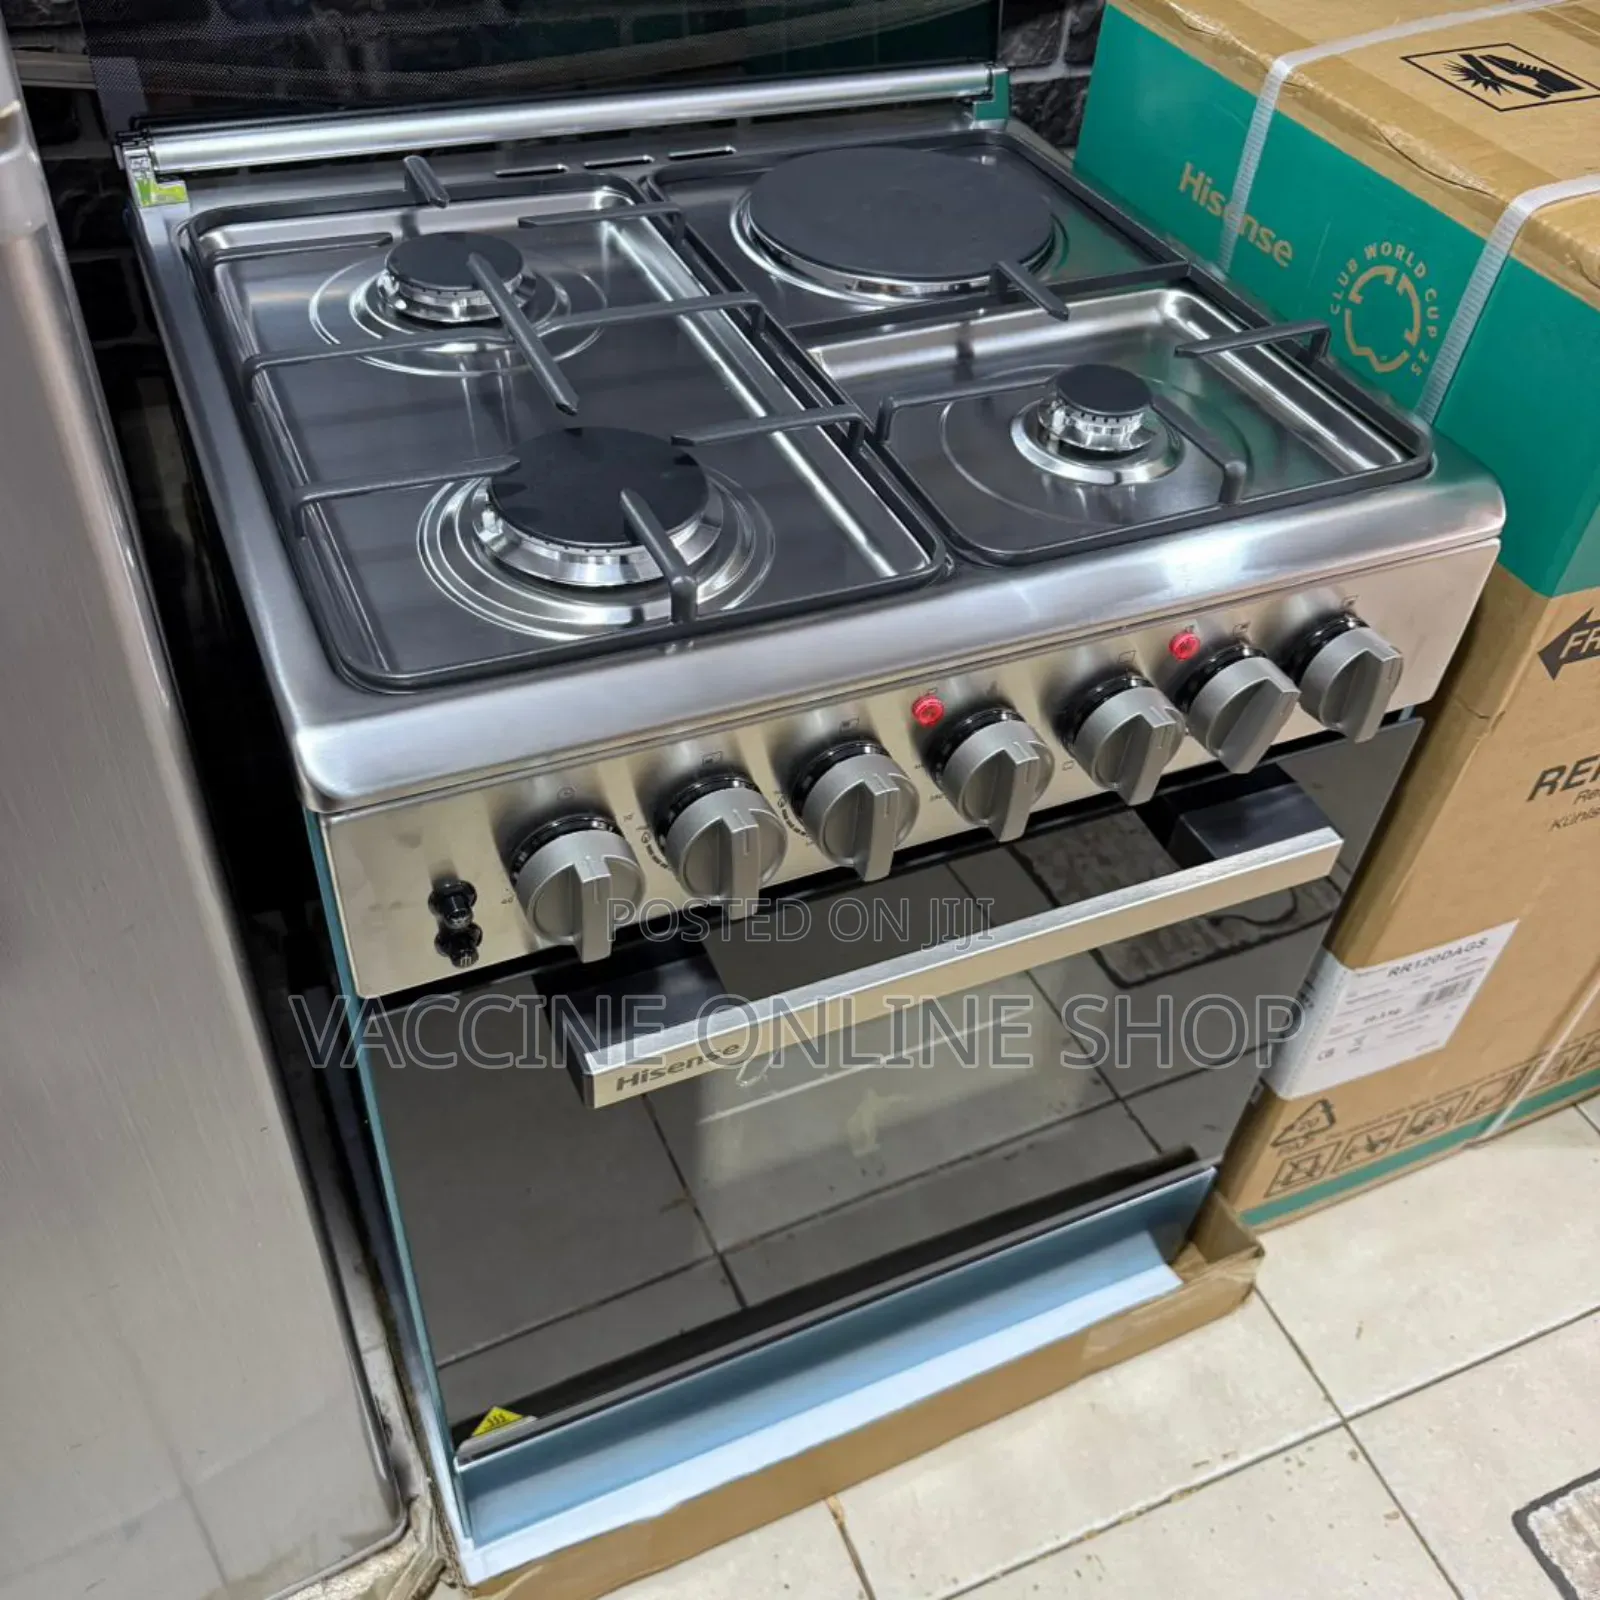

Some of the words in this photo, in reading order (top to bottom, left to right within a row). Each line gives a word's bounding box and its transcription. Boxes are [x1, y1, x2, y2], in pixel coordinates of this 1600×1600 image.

[1179, 161, 1293, 268] Hisnse
[1330, 258, 1358, 316] CLUB
[1364, 241, 1427, 279] WORLD
[1425, 288, 1440, 338] CUP
[616, 1043, 740, 1091] Hisense
